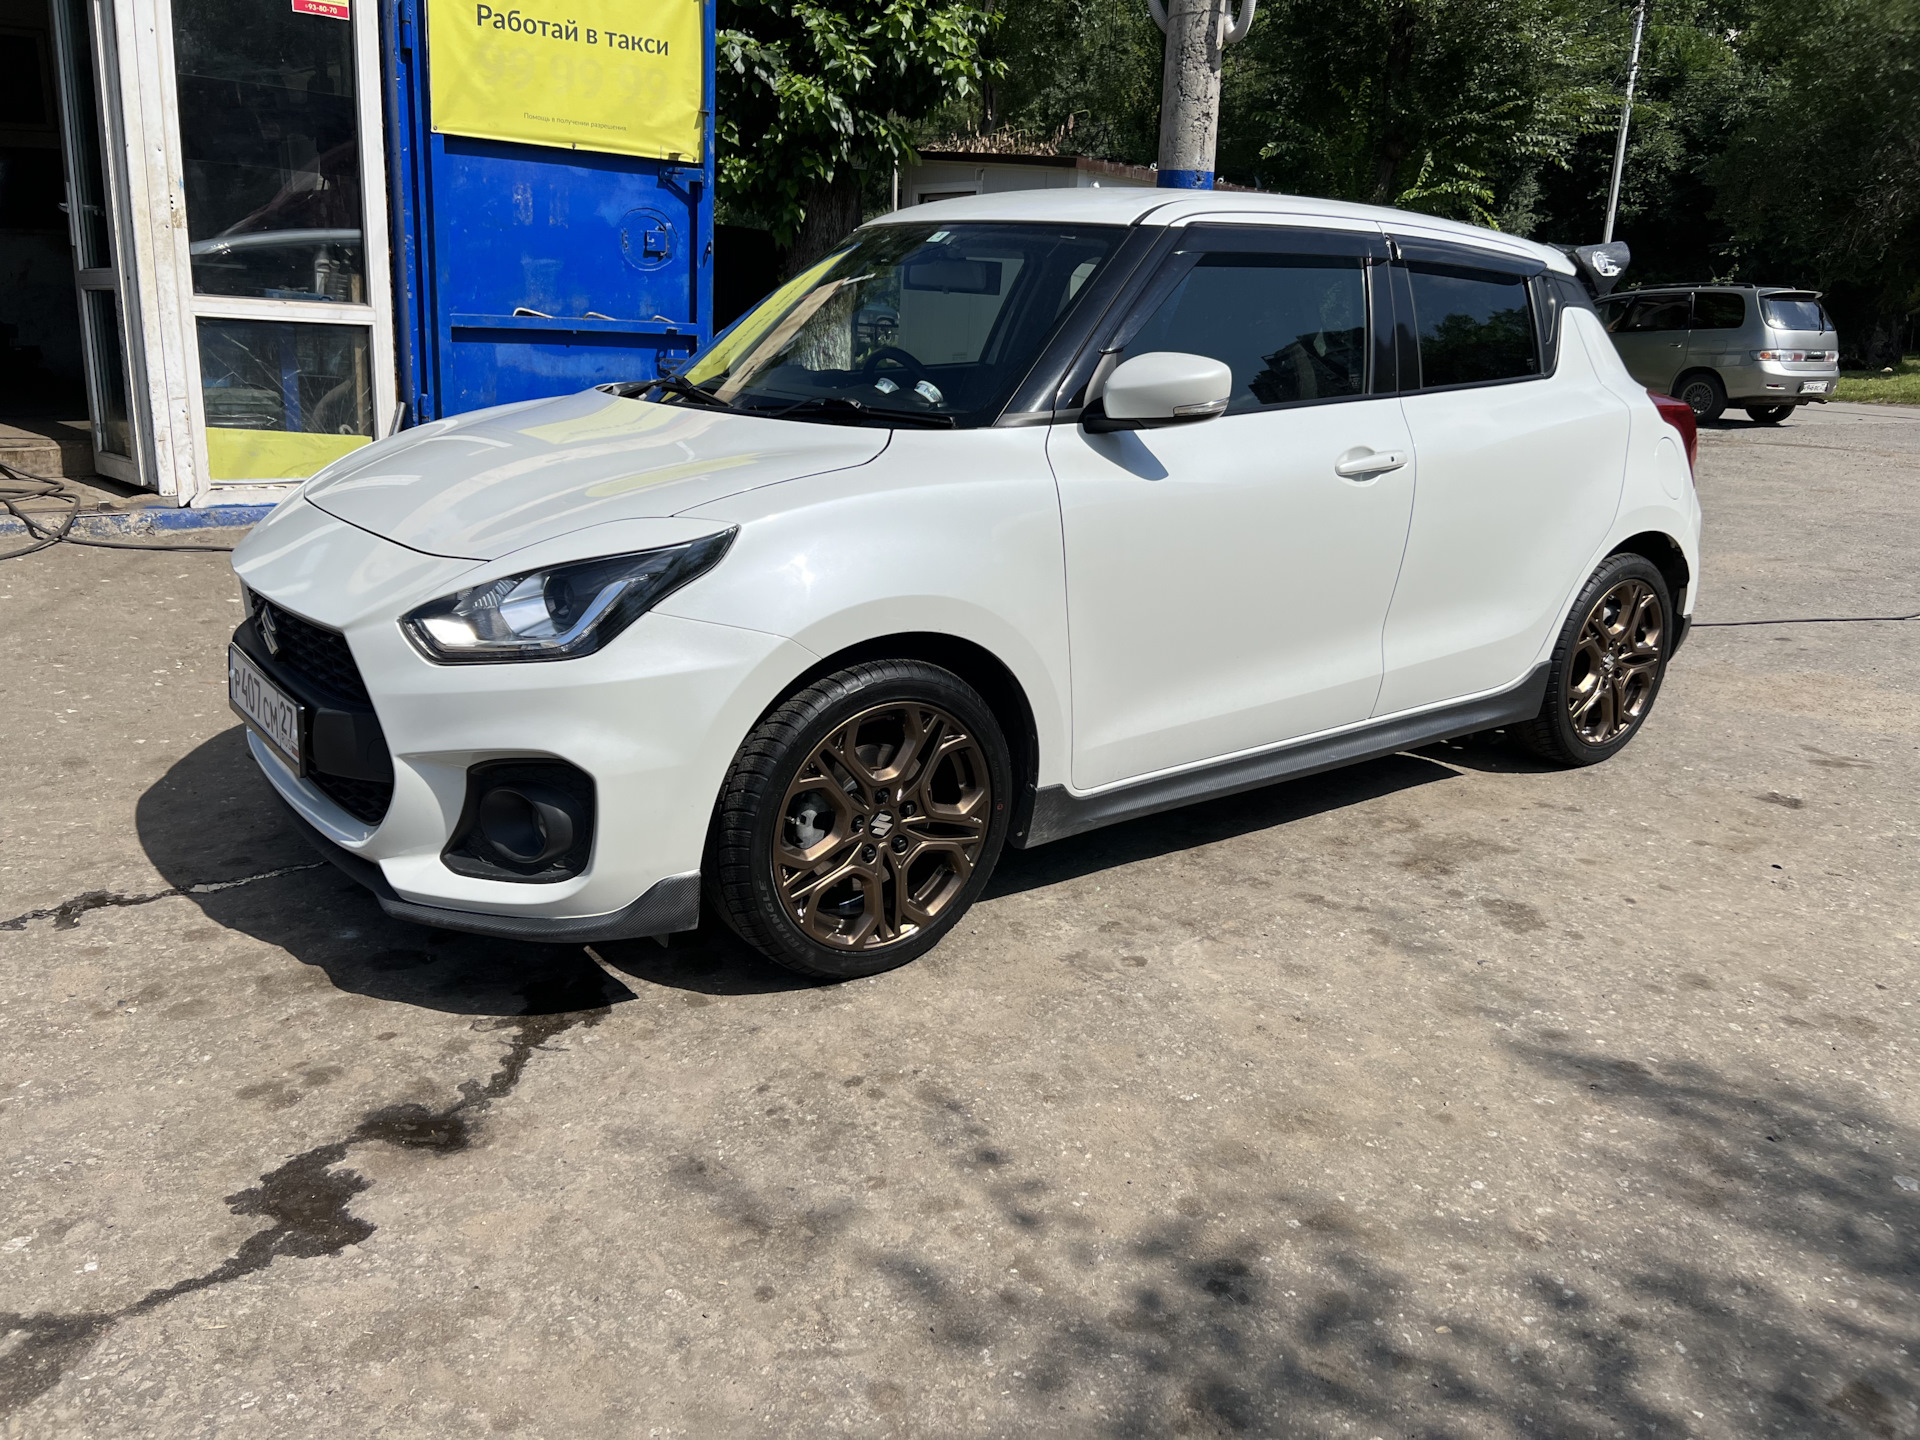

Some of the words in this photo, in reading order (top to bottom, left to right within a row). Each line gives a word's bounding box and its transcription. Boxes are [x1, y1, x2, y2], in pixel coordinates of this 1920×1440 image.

[476, 4, 578, 42] Работай
[586, 28, 598, 45] в
[604, 30, 669, 56] такси
[523, 112, 550, 123] Помощь
[557, 117, 589, 127] получении
